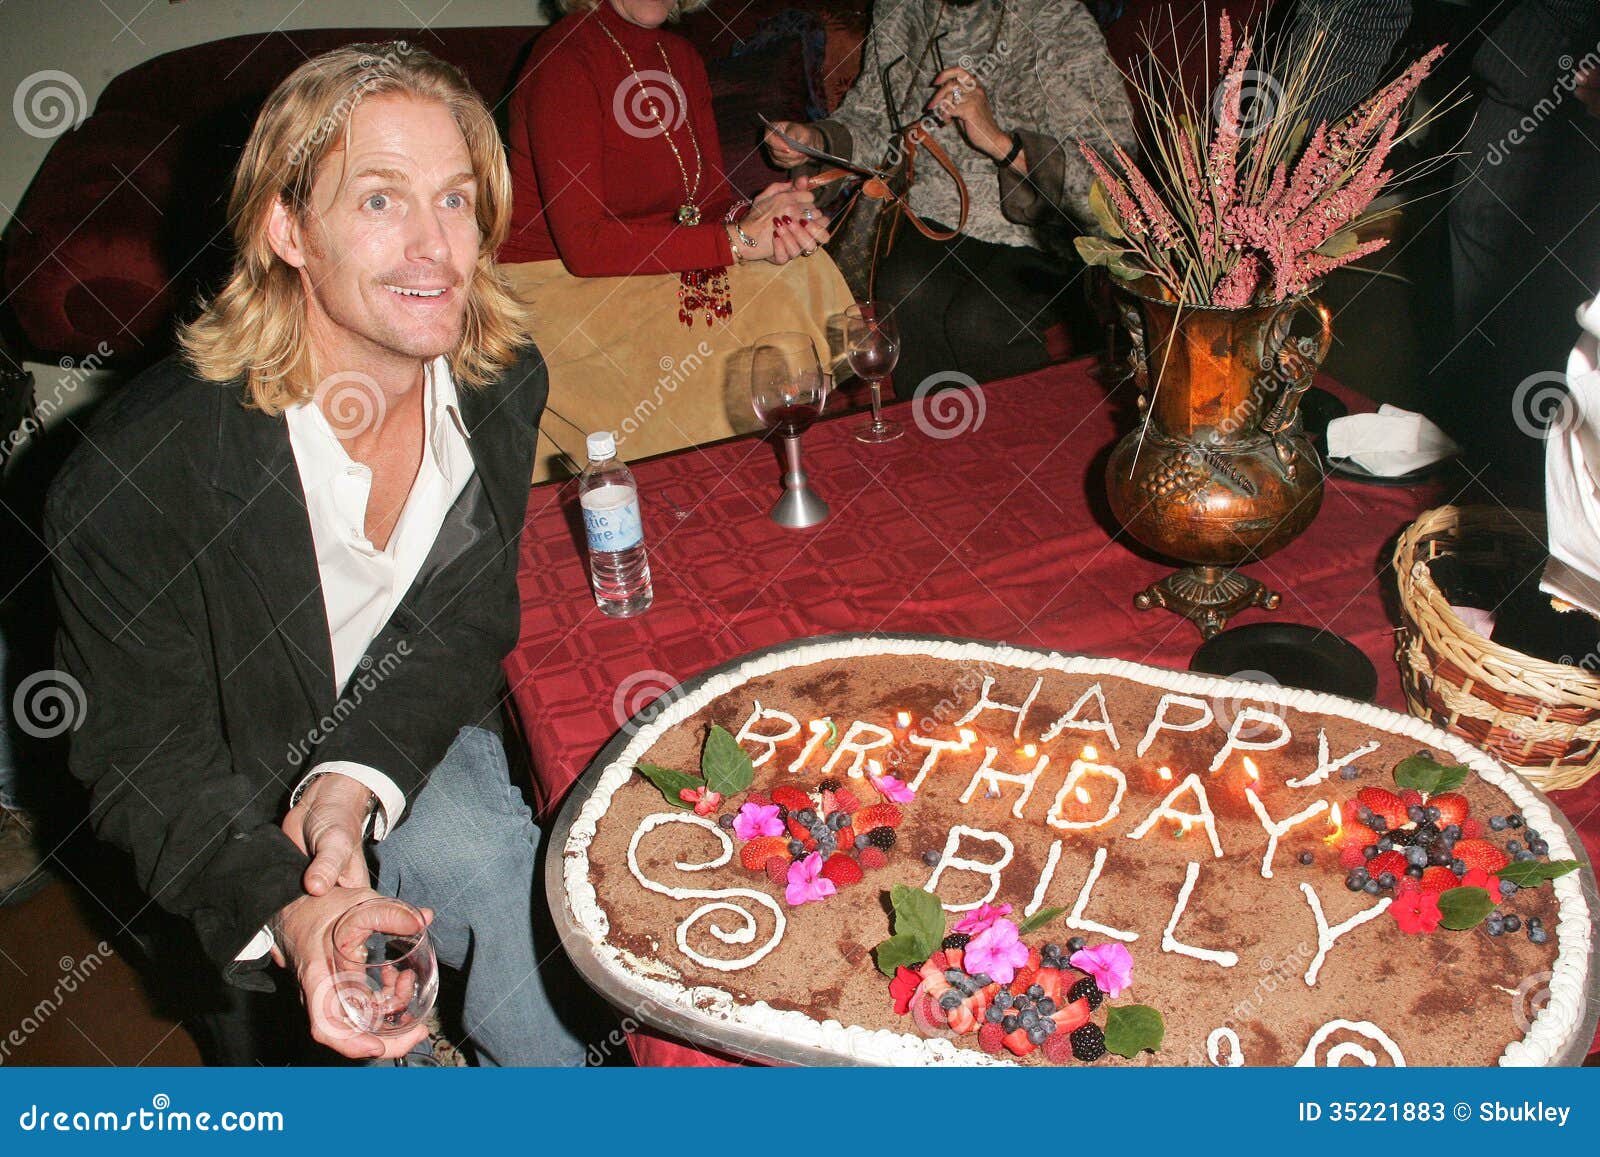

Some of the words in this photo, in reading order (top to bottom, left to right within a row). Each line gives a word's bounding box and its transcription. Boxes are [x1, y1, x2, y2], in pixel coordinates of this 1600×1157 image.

[735, 700, 1329, 878] BIRTHDAY
[952, 675, 1381, 788] HAPPY
[923, 824, 1393, 986] BILLY
